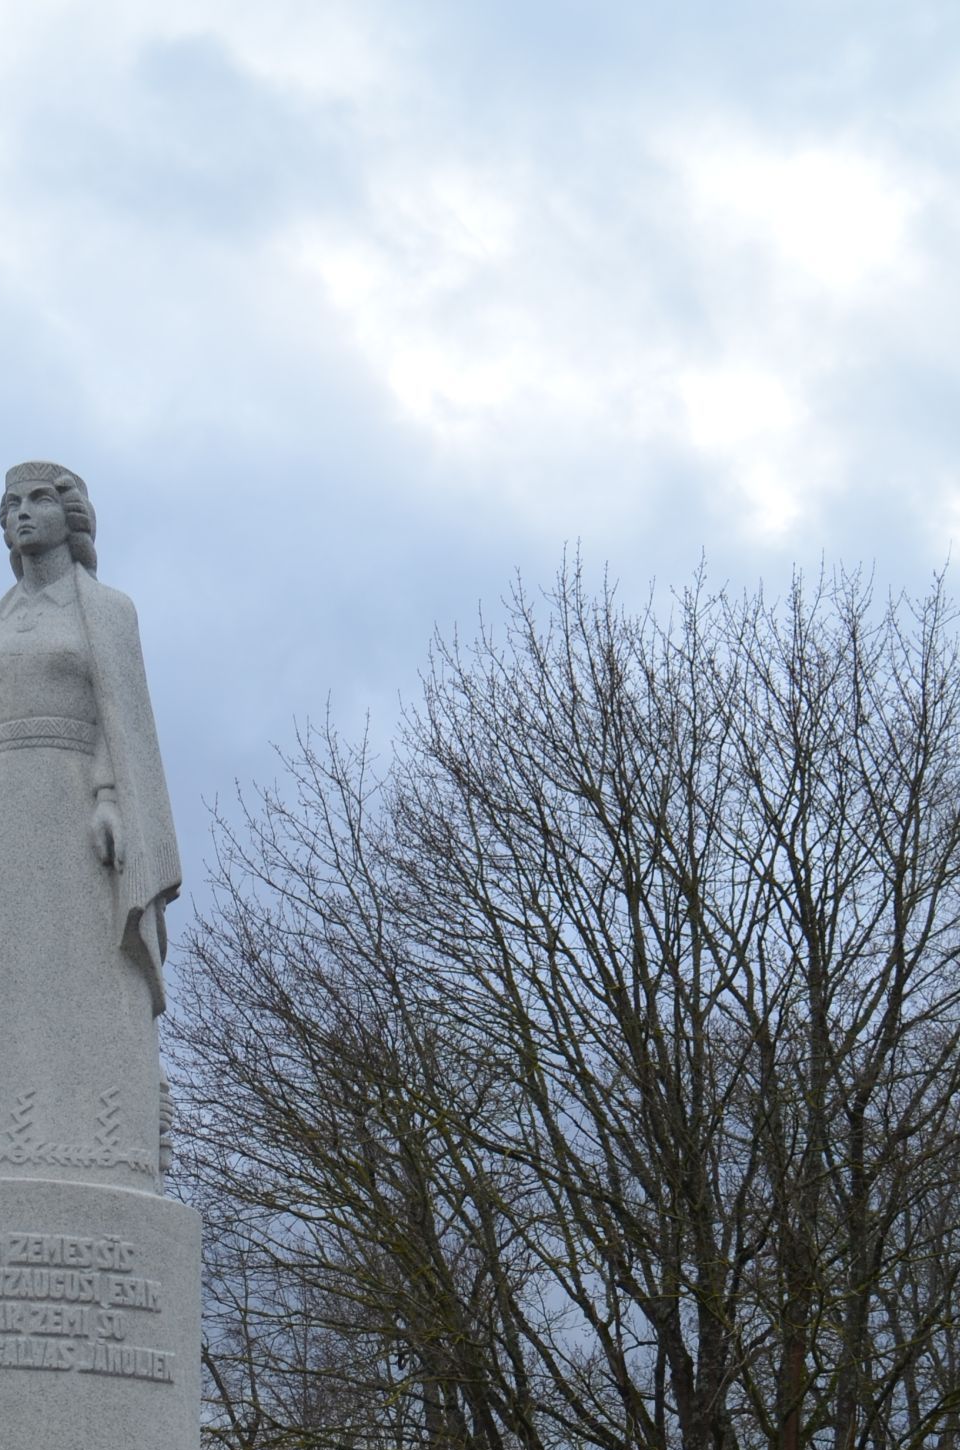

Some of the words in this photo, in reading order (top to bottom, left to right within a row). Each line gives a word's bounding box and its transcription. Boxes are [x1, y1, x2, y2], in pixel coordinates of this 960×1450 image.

[8, 1231, 92, 1268] ZEMES
[105, 1275, 162, 1313] ESAM
[29, 1302, 89, 1338] ZEMI
